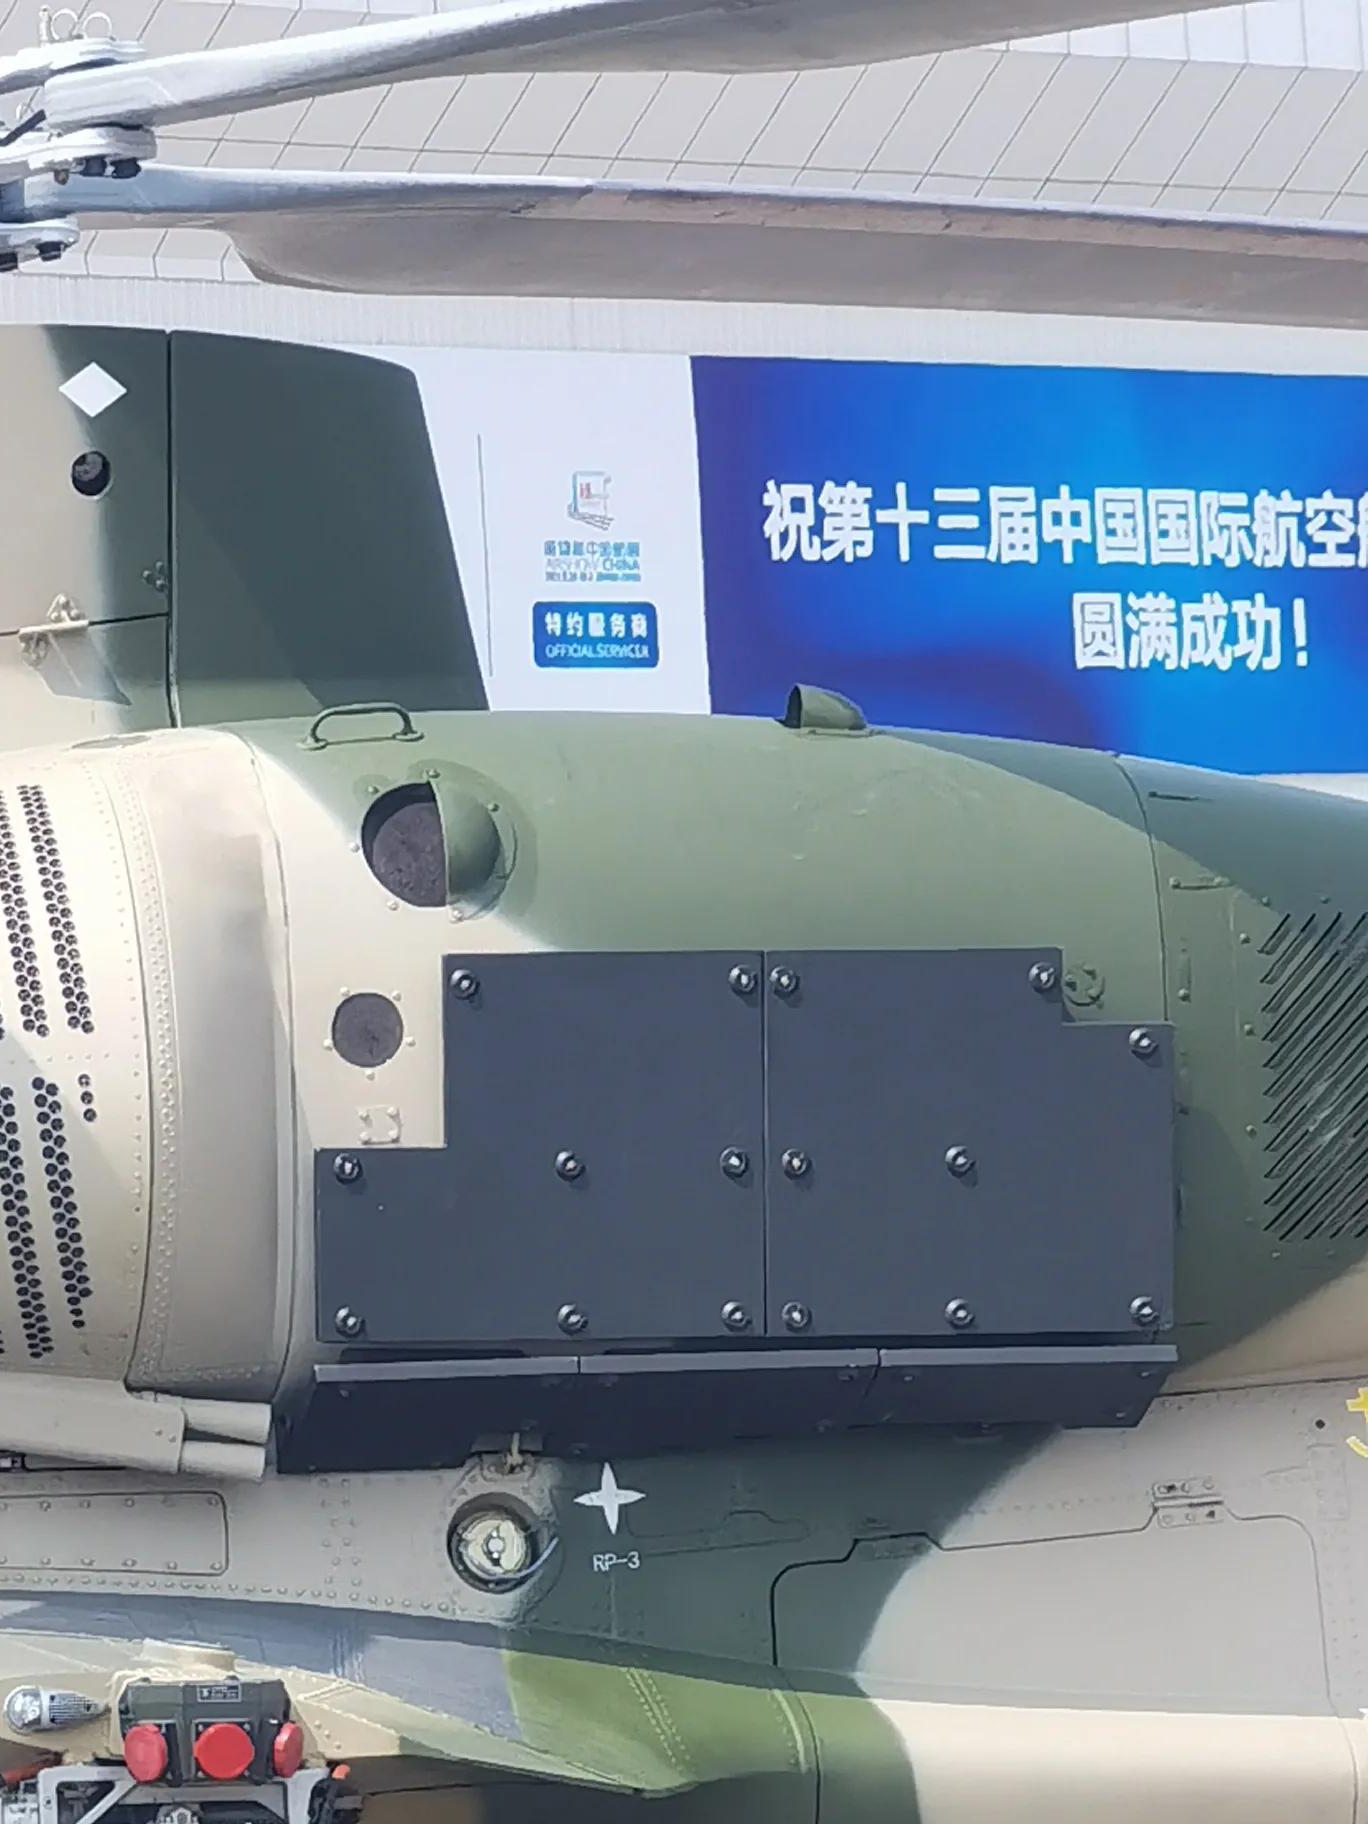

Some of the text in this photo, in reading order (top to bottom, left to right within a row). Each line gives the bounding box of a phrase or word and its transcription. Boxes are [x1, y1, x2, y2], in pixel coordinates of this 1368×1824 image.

[762, 479, 1368, 569] 祝第十三届中国国际航空
[592, 1550, 641, 1573] RP-3
